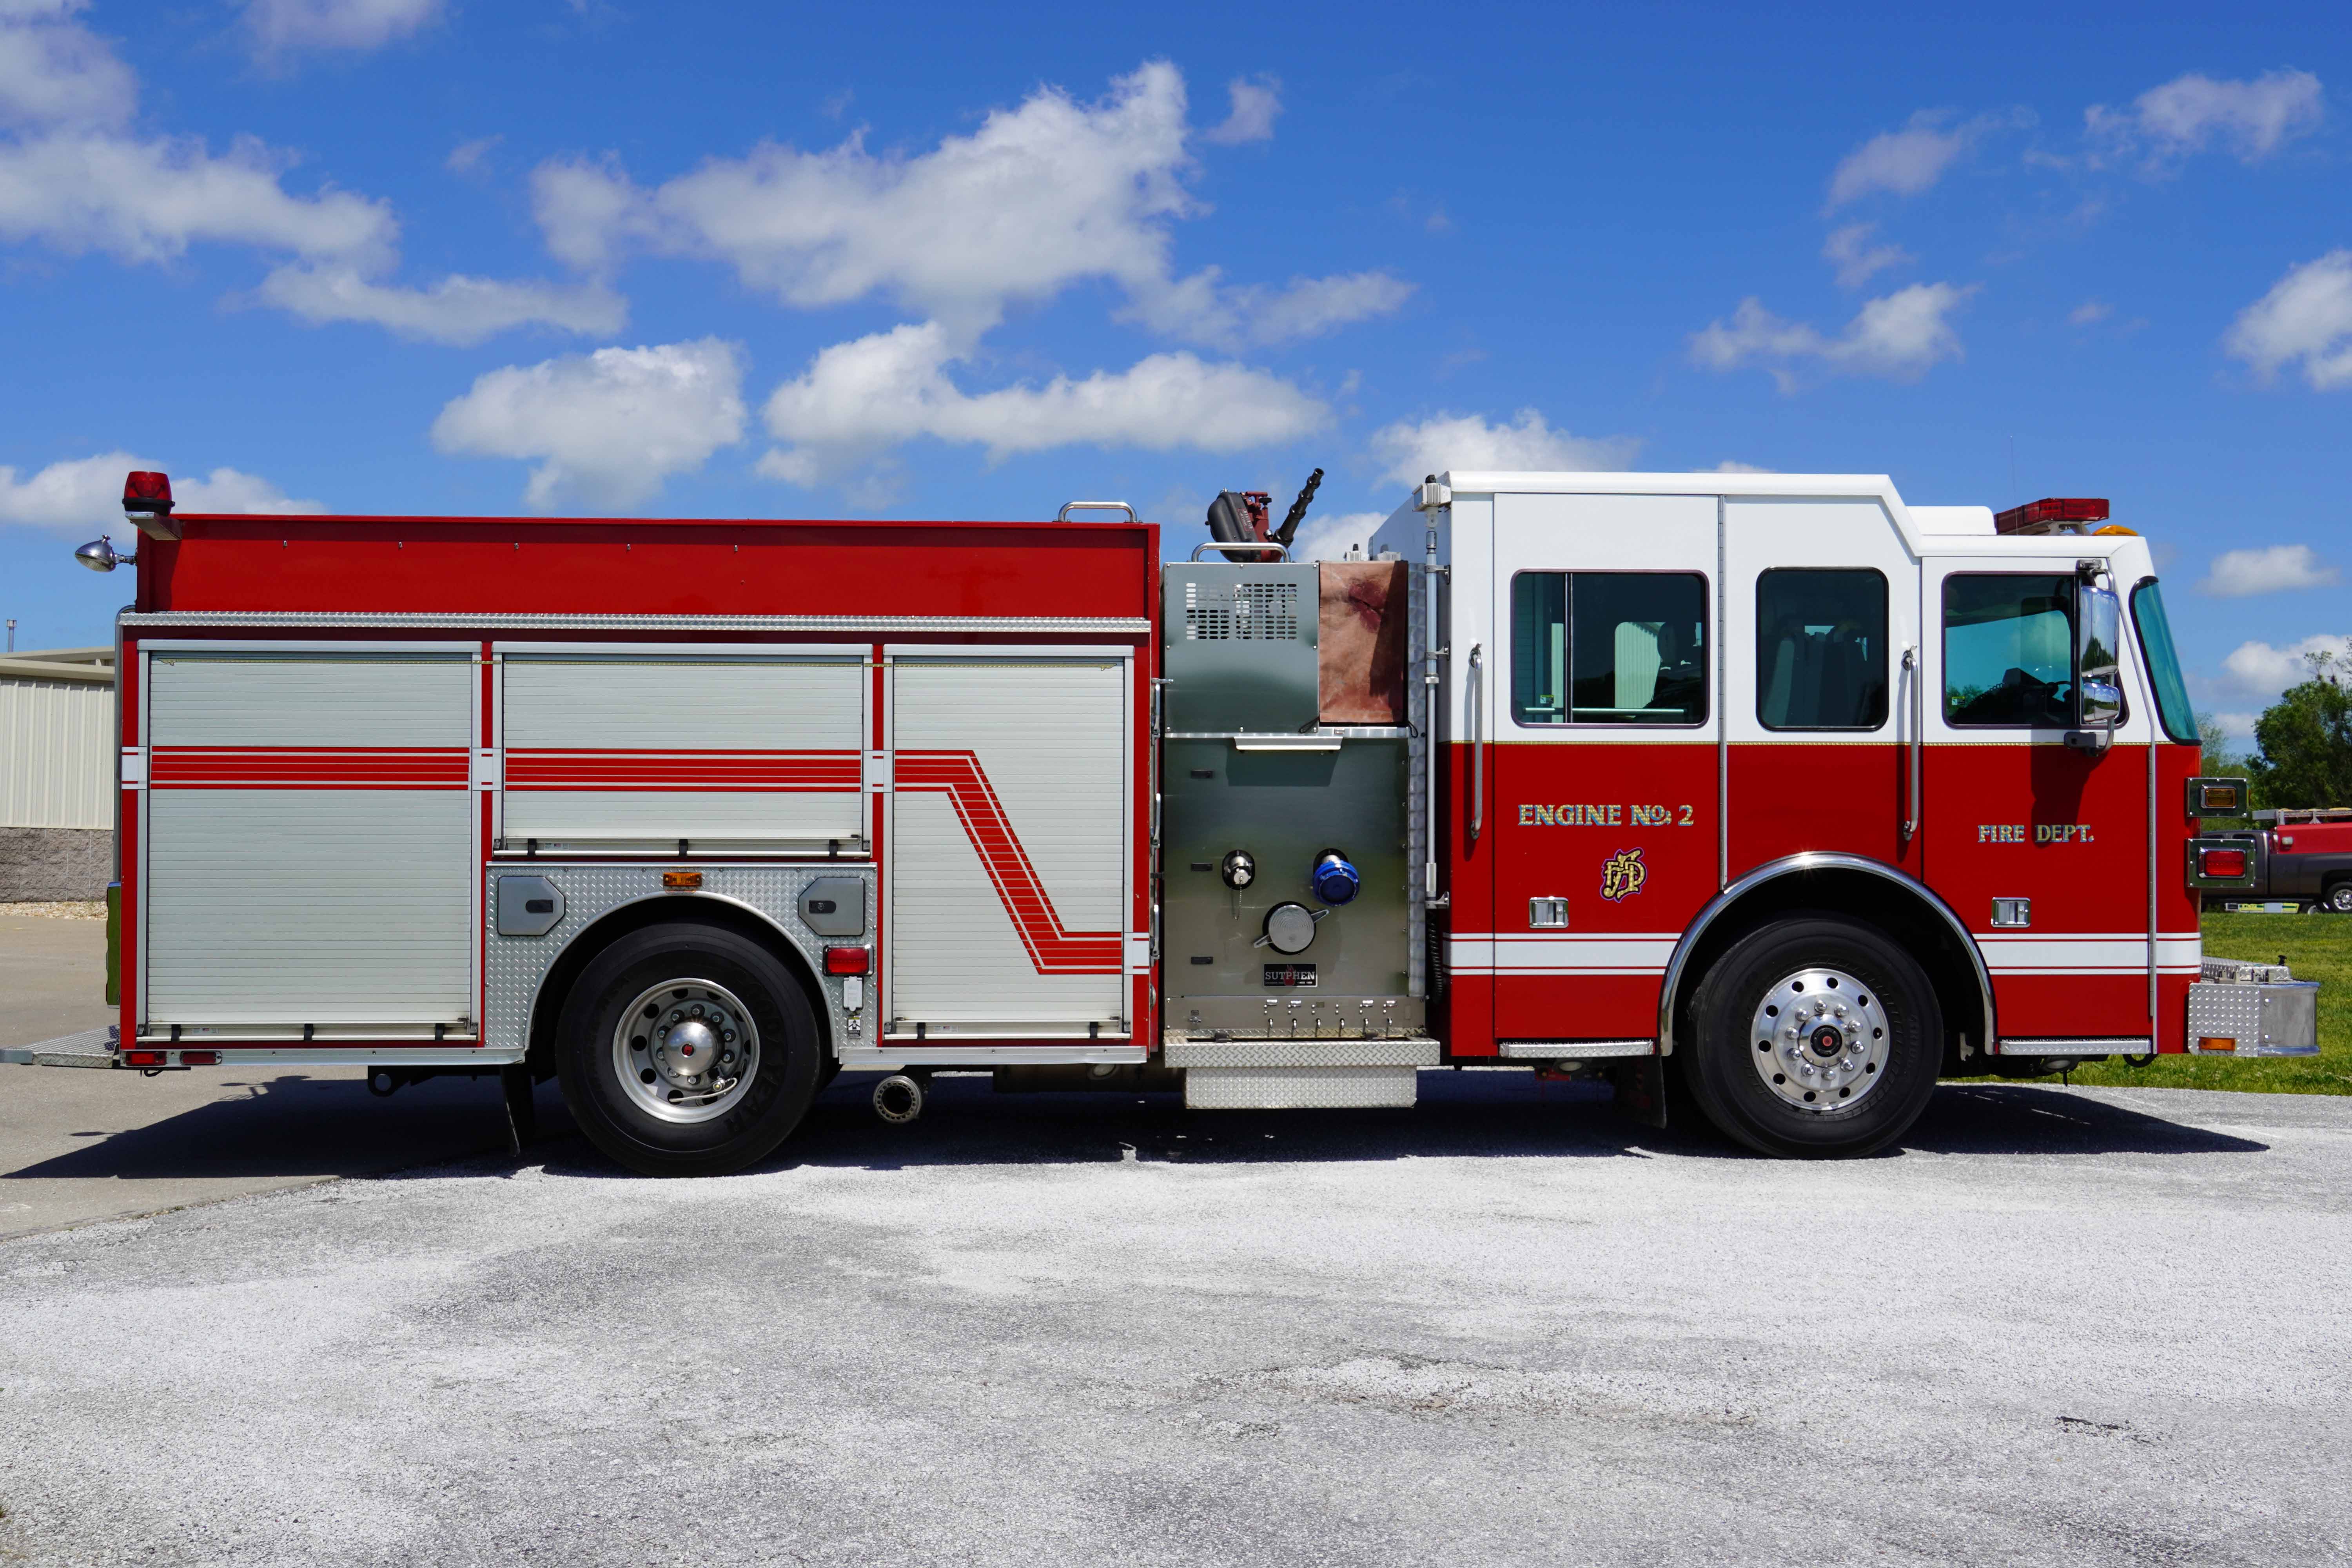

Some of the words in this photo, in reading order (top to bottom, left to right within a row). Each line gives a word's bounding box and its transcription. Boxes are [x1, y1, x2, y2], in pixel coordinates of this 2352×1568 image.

[1518, 804, 1622, 826] ENGINE
[1678, 804, 1694, 826] 2
[1978, 825, 2025, 842] FIRE
[2035, 825, 2094, 842] DEPT.
[1265, 971, 1315, 980] SUTPHEN
